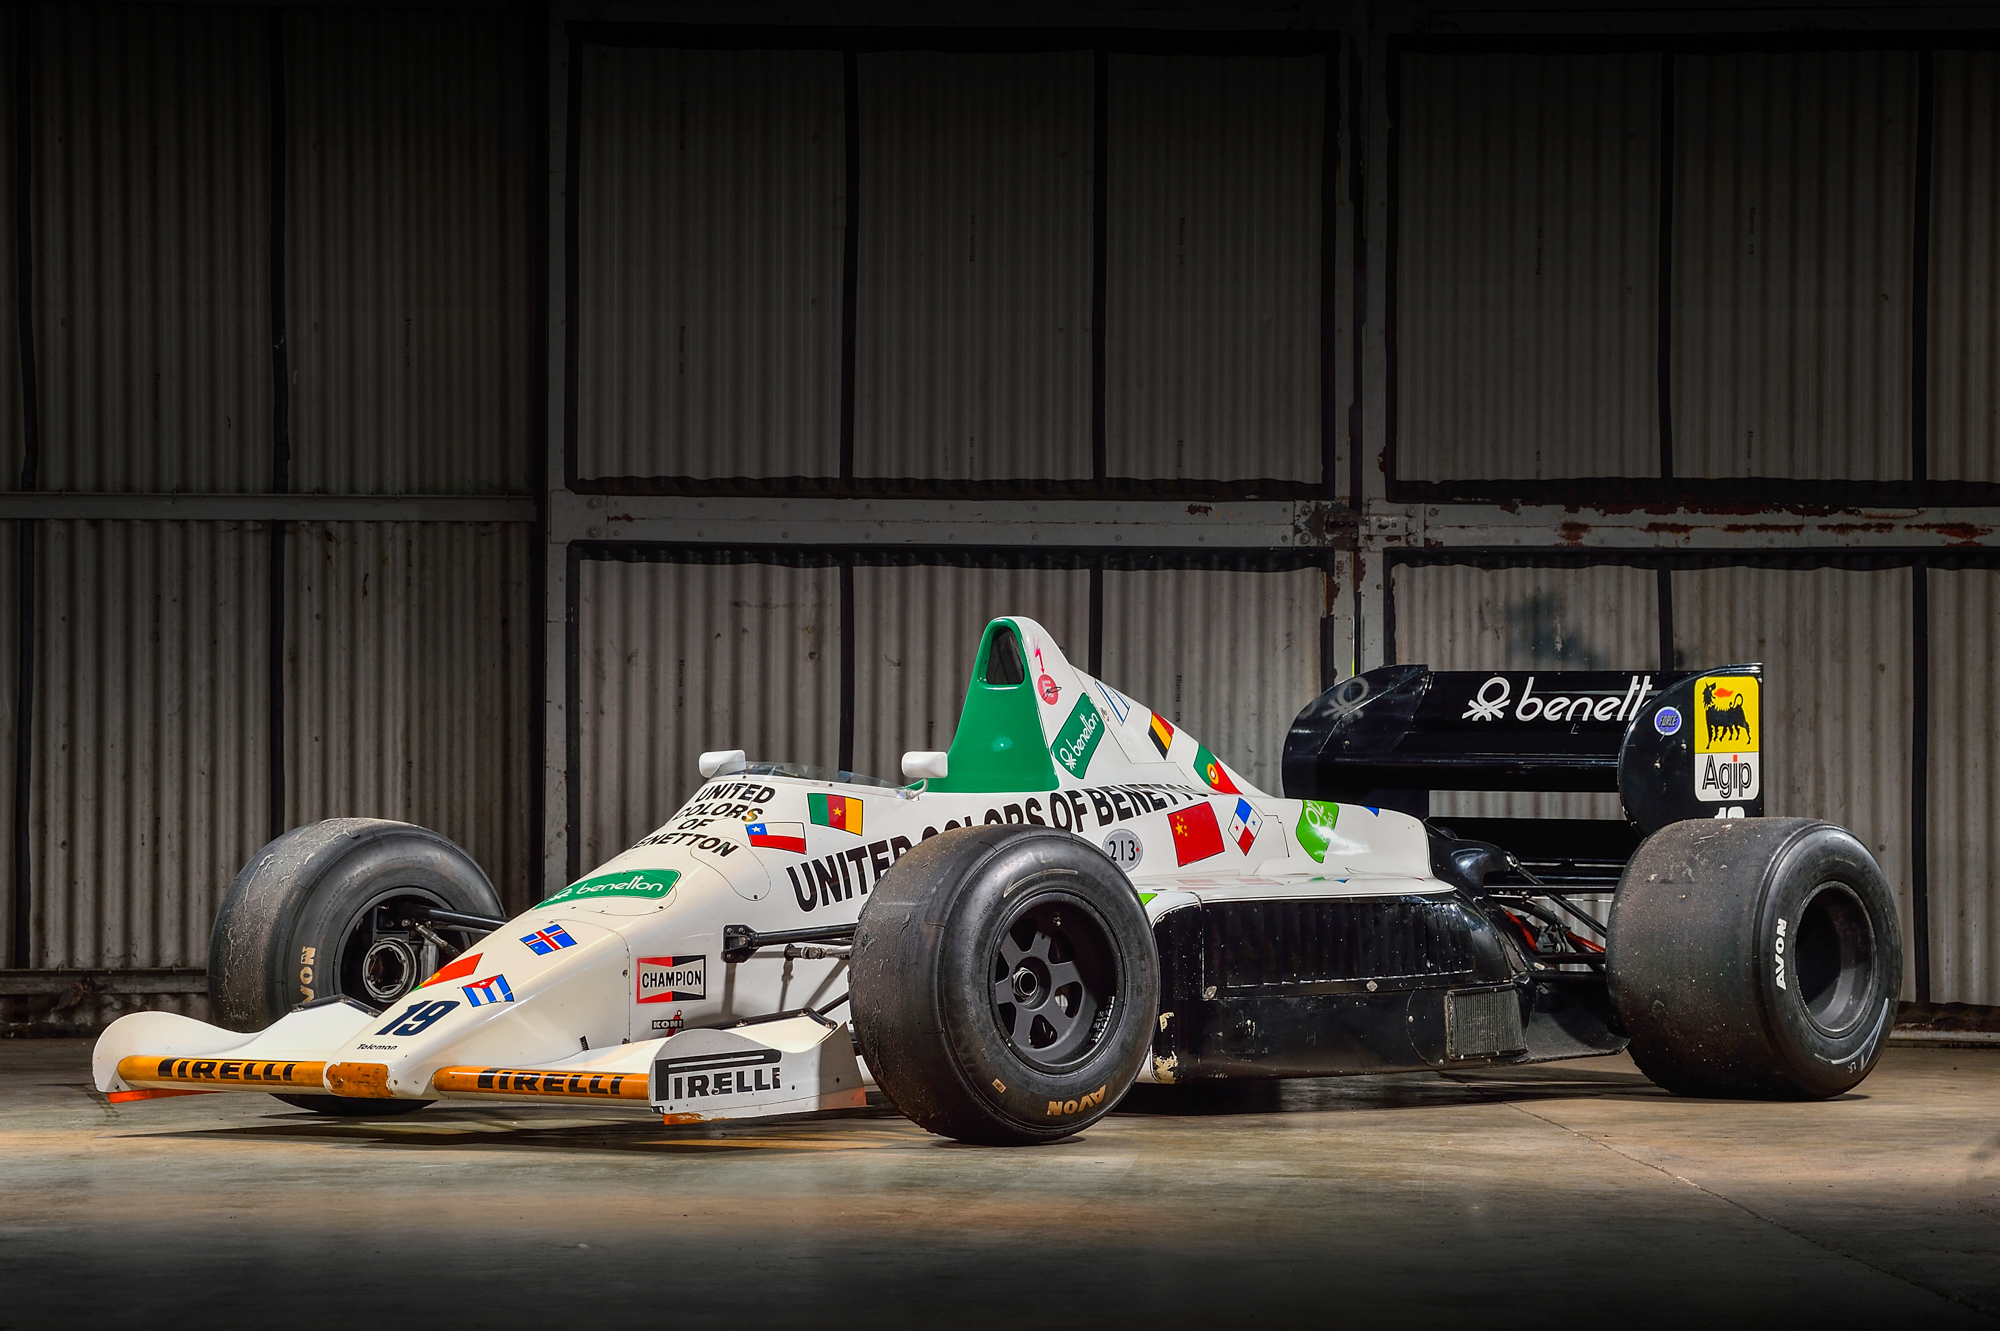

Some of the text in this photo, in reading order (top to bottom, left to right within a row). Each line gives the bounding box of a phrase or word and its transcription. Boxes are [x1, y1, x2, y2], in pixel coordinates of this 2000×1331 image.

[1515, 676, 1653, 722] benett
[1065, 713, 1099, 757] benetton
[694, 782, 776, 804] UNITED
[1702, 754, 1752, 799] Agip
[672, 802, 764, 822] COLORS
[677, 818, 716, 830] OF
[1049, 790, 1088, 833] OF
[1108, 840, 1136, 861] 213
[576, 875, 664, 894] benetton
[1775, 918, 1787, 990] AVON
[300, 946, 316, 1004] VON
[642, 970, 701, 988] CHAMPION
[374, 1000, 460, 1036] 19
[653, 1020, 683, 1028] KONI
[655, 1049, 782, 1101] PIRELLI
[1047, 1084, 1106, 1115] AVON
